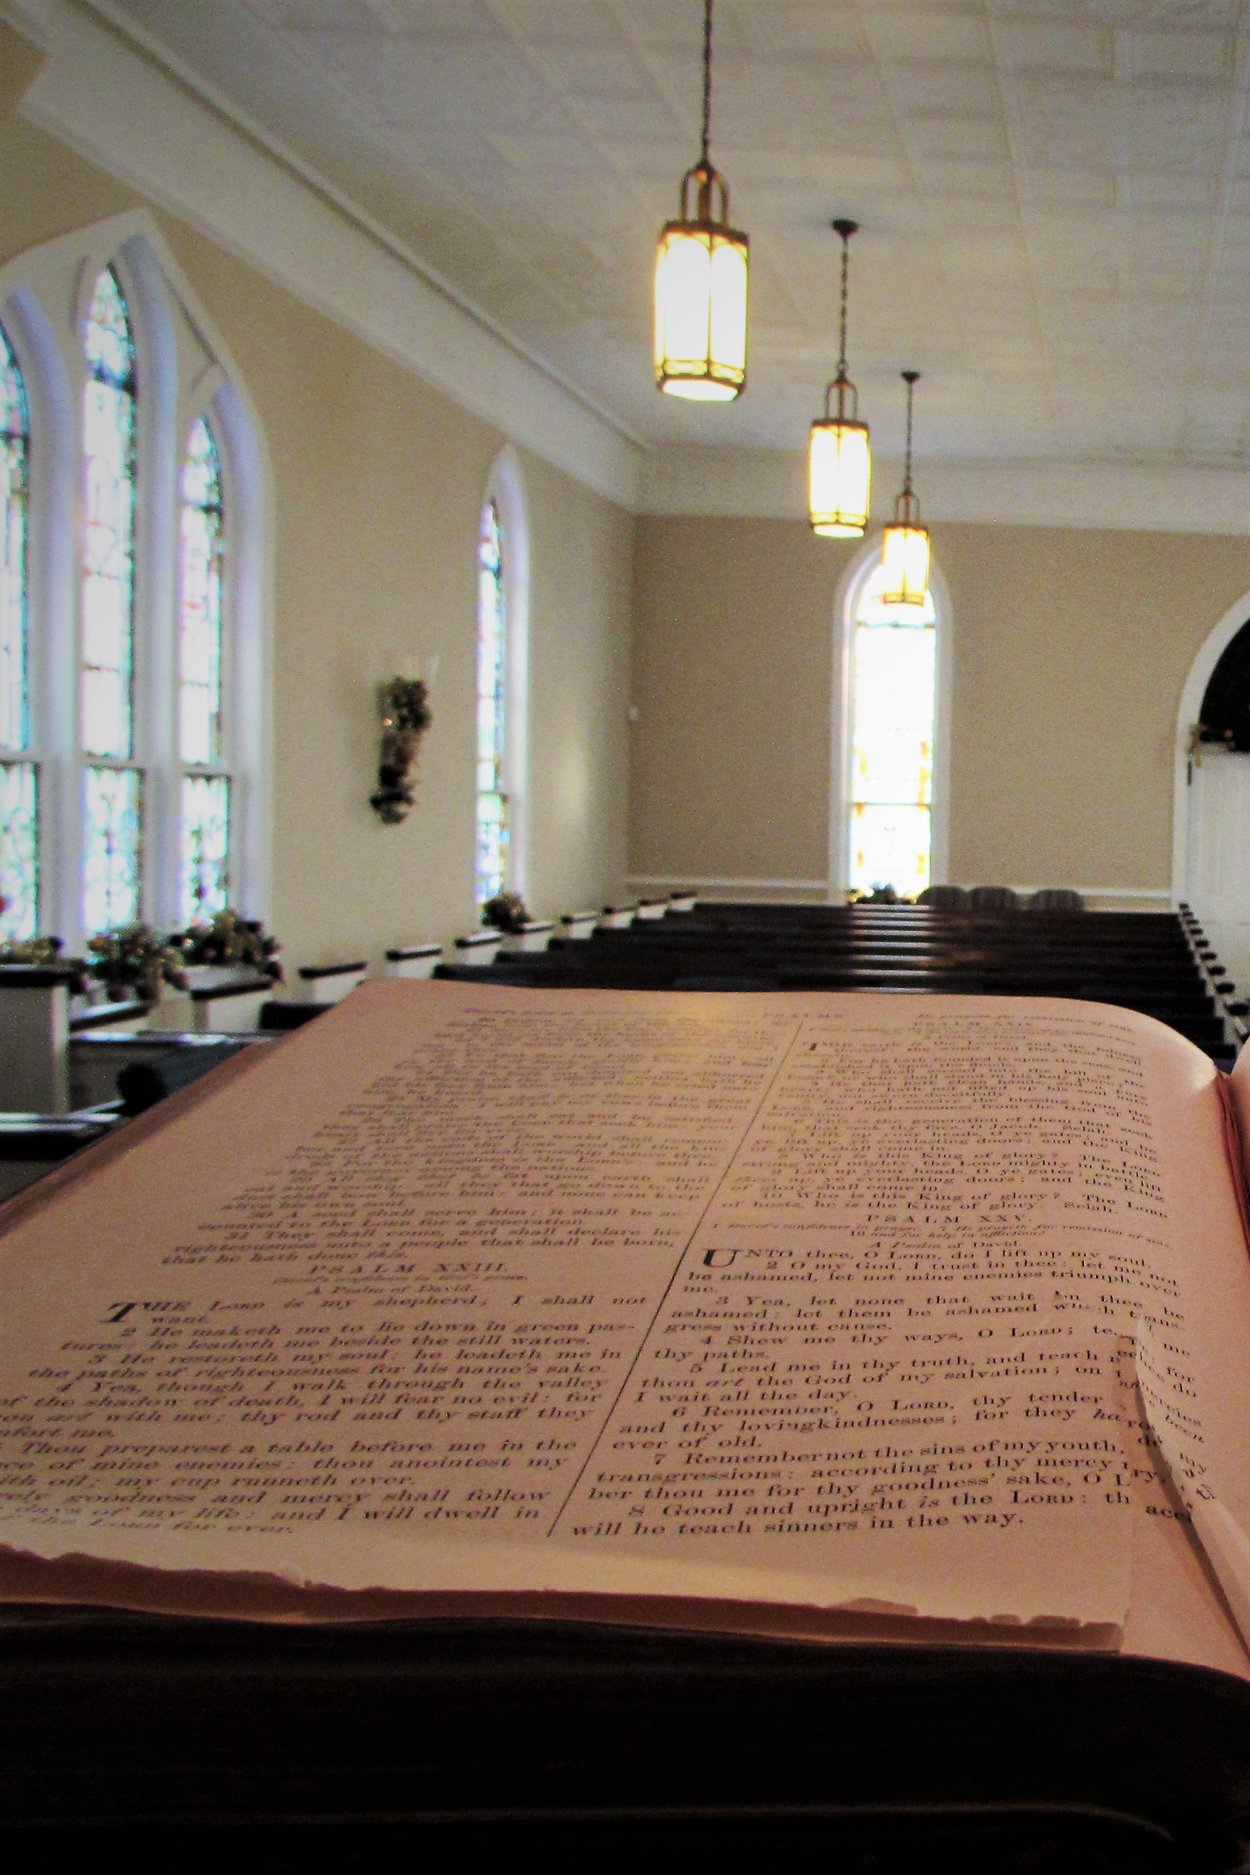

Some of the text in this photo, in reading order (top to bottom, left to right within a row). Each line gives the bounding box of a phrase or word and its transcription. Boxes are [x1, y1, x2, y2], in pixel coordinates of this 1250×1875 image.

[868, 1201, 897, 1209] the
[906, 1201, 951, 1211] King
[960, 1202, 980, 1210] of
[867, 1214, 1032, 1224] PSALM XXV.
[702, 1335, 713, 1345] 4
[727, 1335, 788, 1346] Shew
[804, 1336, 836, 1345] me
[851, 1334, 889, 1346] thy
[905, 1332, 963, 1344] ways,
[977, 1329, 993, 1339] O
[654, 1349, 770, 1362] thy paths.
[634, 1388, 857, 1403] I wait all the day.
[672, 1391, 1104, 1418] 6 Remember, O LORD, thy tender
[620, 1406, 1076, 1436] and thy lovingkindnesses; for they
[654, 1439, 1125, 1465] 7 Remember not the sins of my youth,
[628, 1490, 1088, 1517] 8 Good and upright is the LORD:
[572, 1511, 1024, 1536] will he teach sinners in the way.
